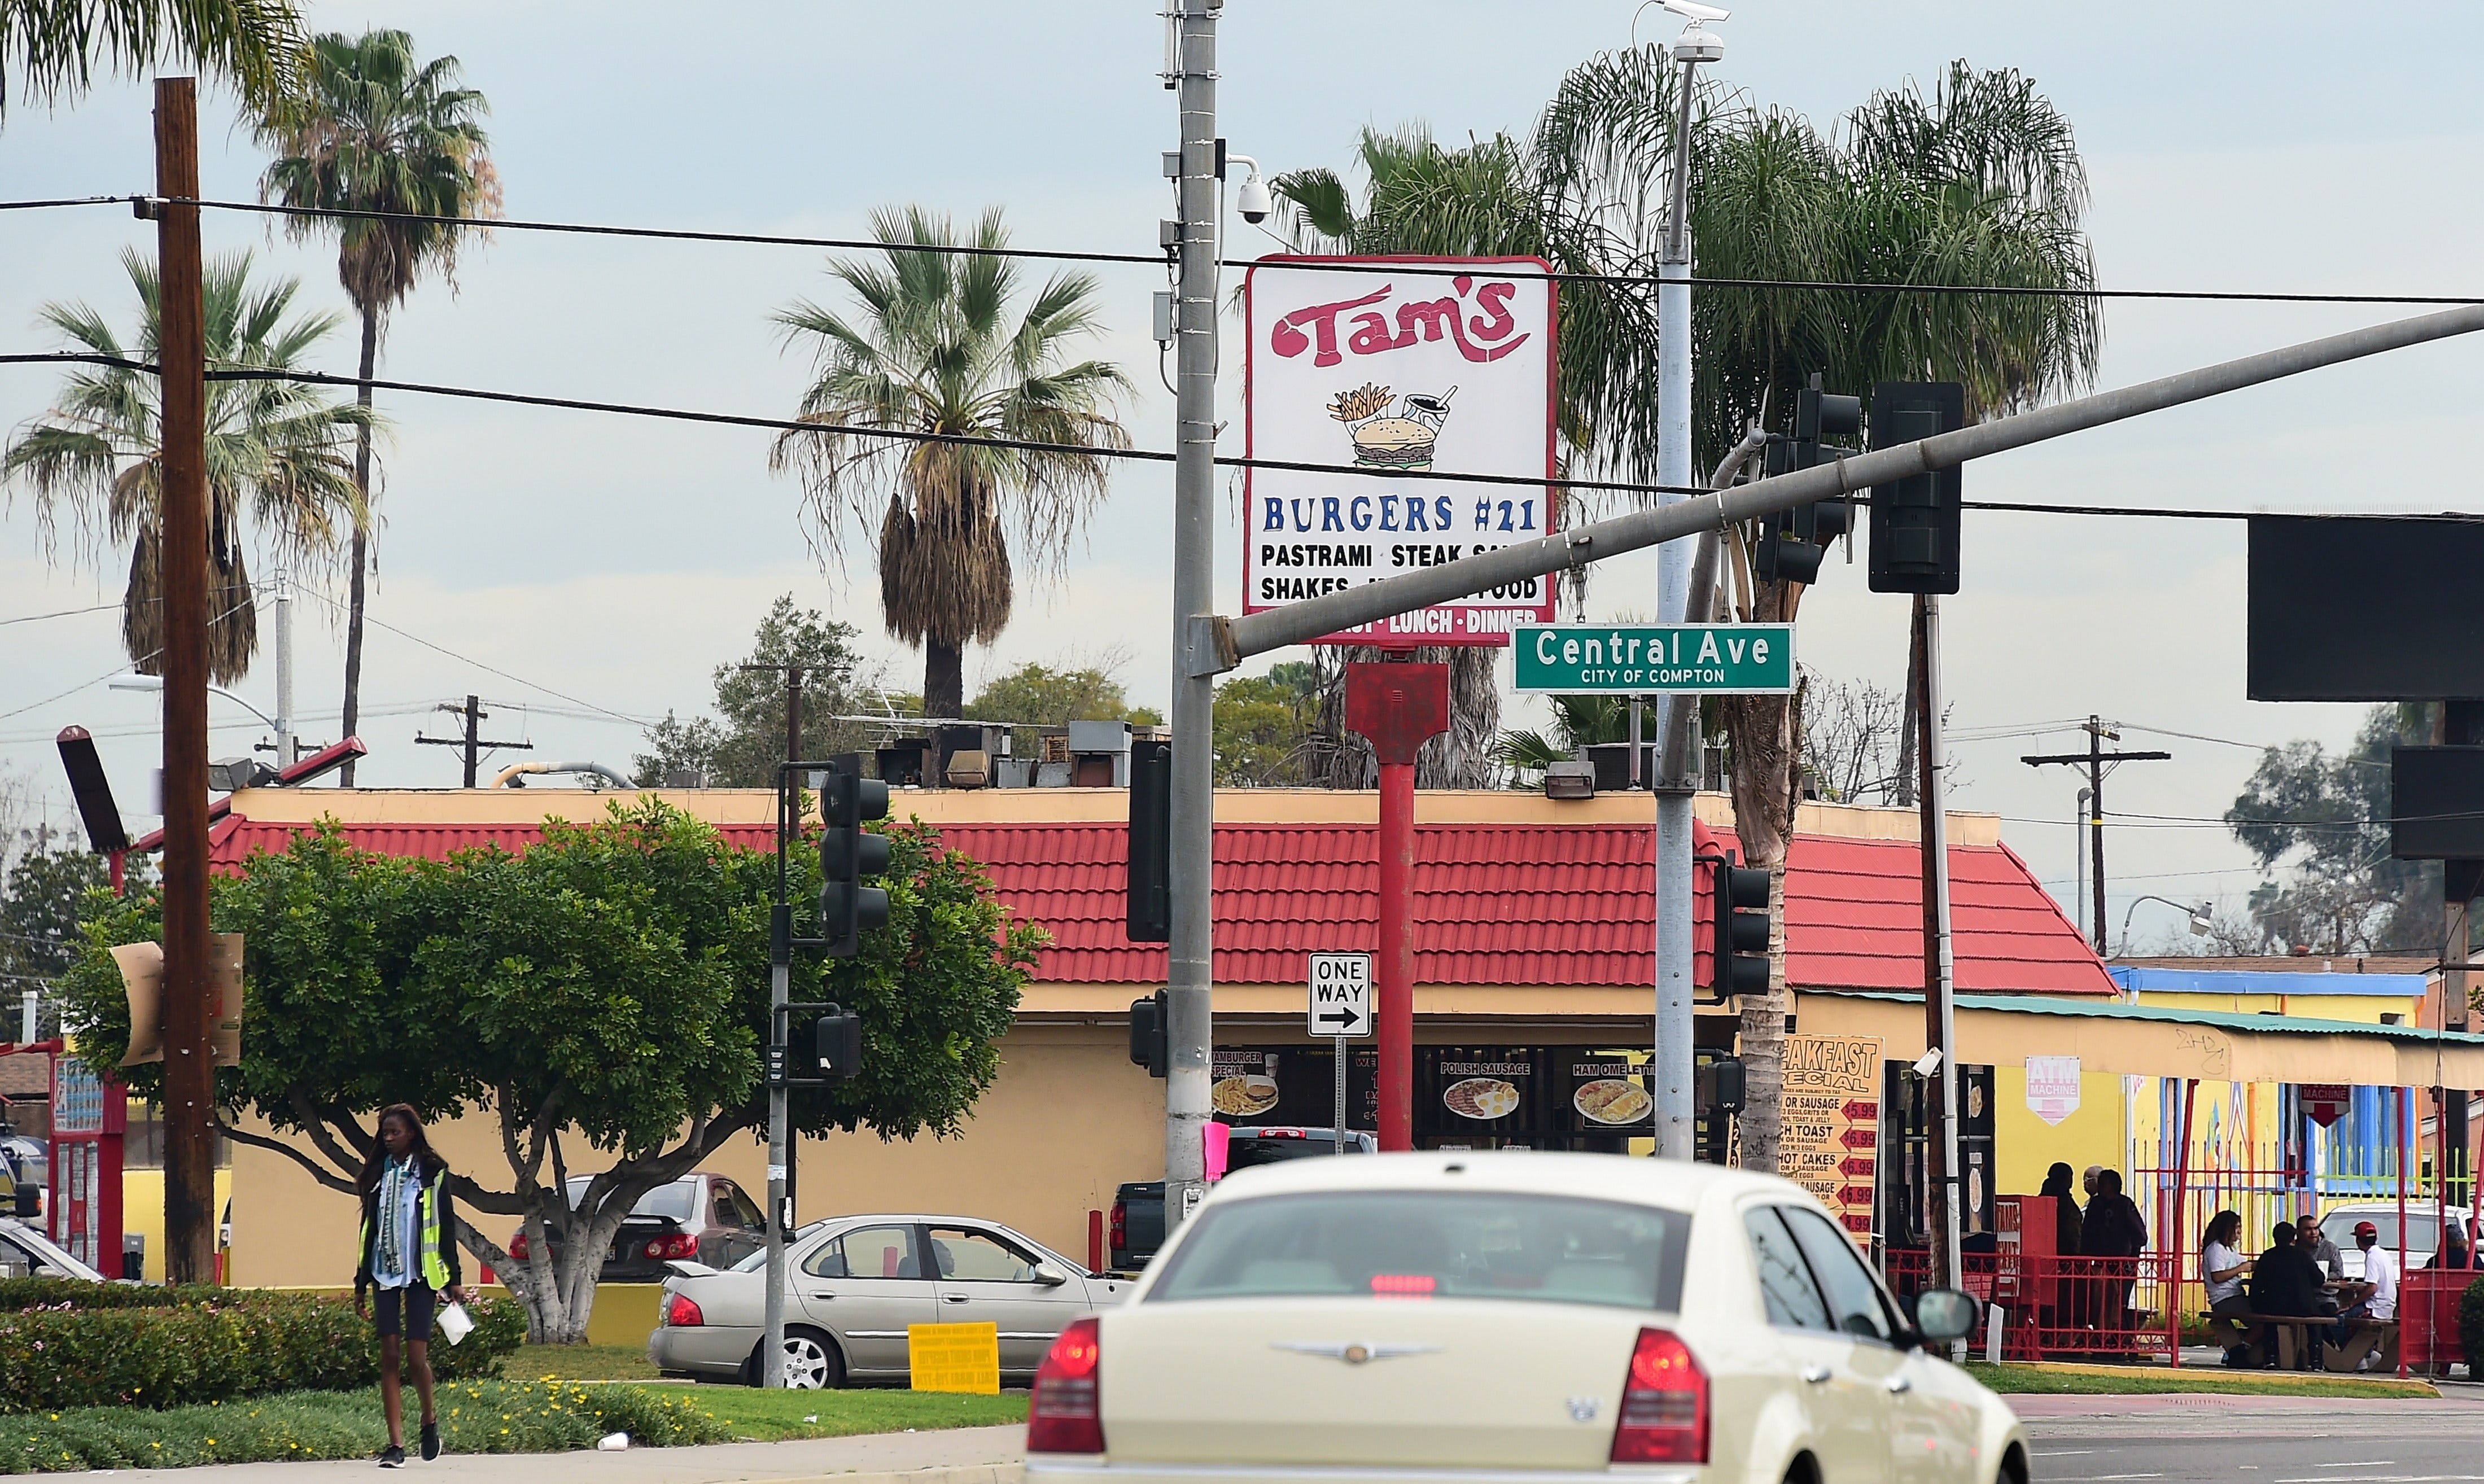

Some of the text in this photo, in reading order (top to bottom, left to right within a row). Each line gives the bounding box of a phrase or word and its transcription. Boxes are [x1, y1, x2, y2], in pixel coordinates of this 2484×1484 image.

[1271, 275, 1530, 367] Tam's
[1263, 495, 1536, 533] BURGERS #21
[1261, 545, 1372, 567] PASTRAMI
[1392, 545, 1462, 567] STEAK
[1261, 577, 1349, 599] SHAKES
[1477, 580, 1538, 599] OOD
[1389, 610, 1452, 633] LUNCH
[1466, 610, 1537, 633] DINNER
[1537, 631, 1769, 665] Central Ave
[1581, 669, 1725, 683] CITY OF COMPTON
[1318, 961, 1362, 979] ONE
[1317, 984, 1364, 1002] WAY
[1212, 1051, 1262, 1064] AMBURGER
[1781, 1039, 1877, 1079] EAKFAST
[1441, 1062, 1530, 1075] POLISH SAUSAGE
[1573, 1064, 1655, 1076] HAM OMELETT
[2029, 1060, 2078, 1083] ATM
[1782, 1071, 1869, 1093] ECIAL
[2030, 1084, 2076, 1095] MACHINE
[2303, 1089, 2346, 1100] MACHINE
[1785, 1097, 1839, 1109] OR SAUSAGE
[1845, 1104, 1876, 1117] $5.99
[1796, 1126, 1834, 1137] TOAST
[1844, 1131, 1875, 1145] $6.99
[1779, 1153, 1836, 1165] HOT CAKES
[1842, 1160, 1874, 1175] $6.99
